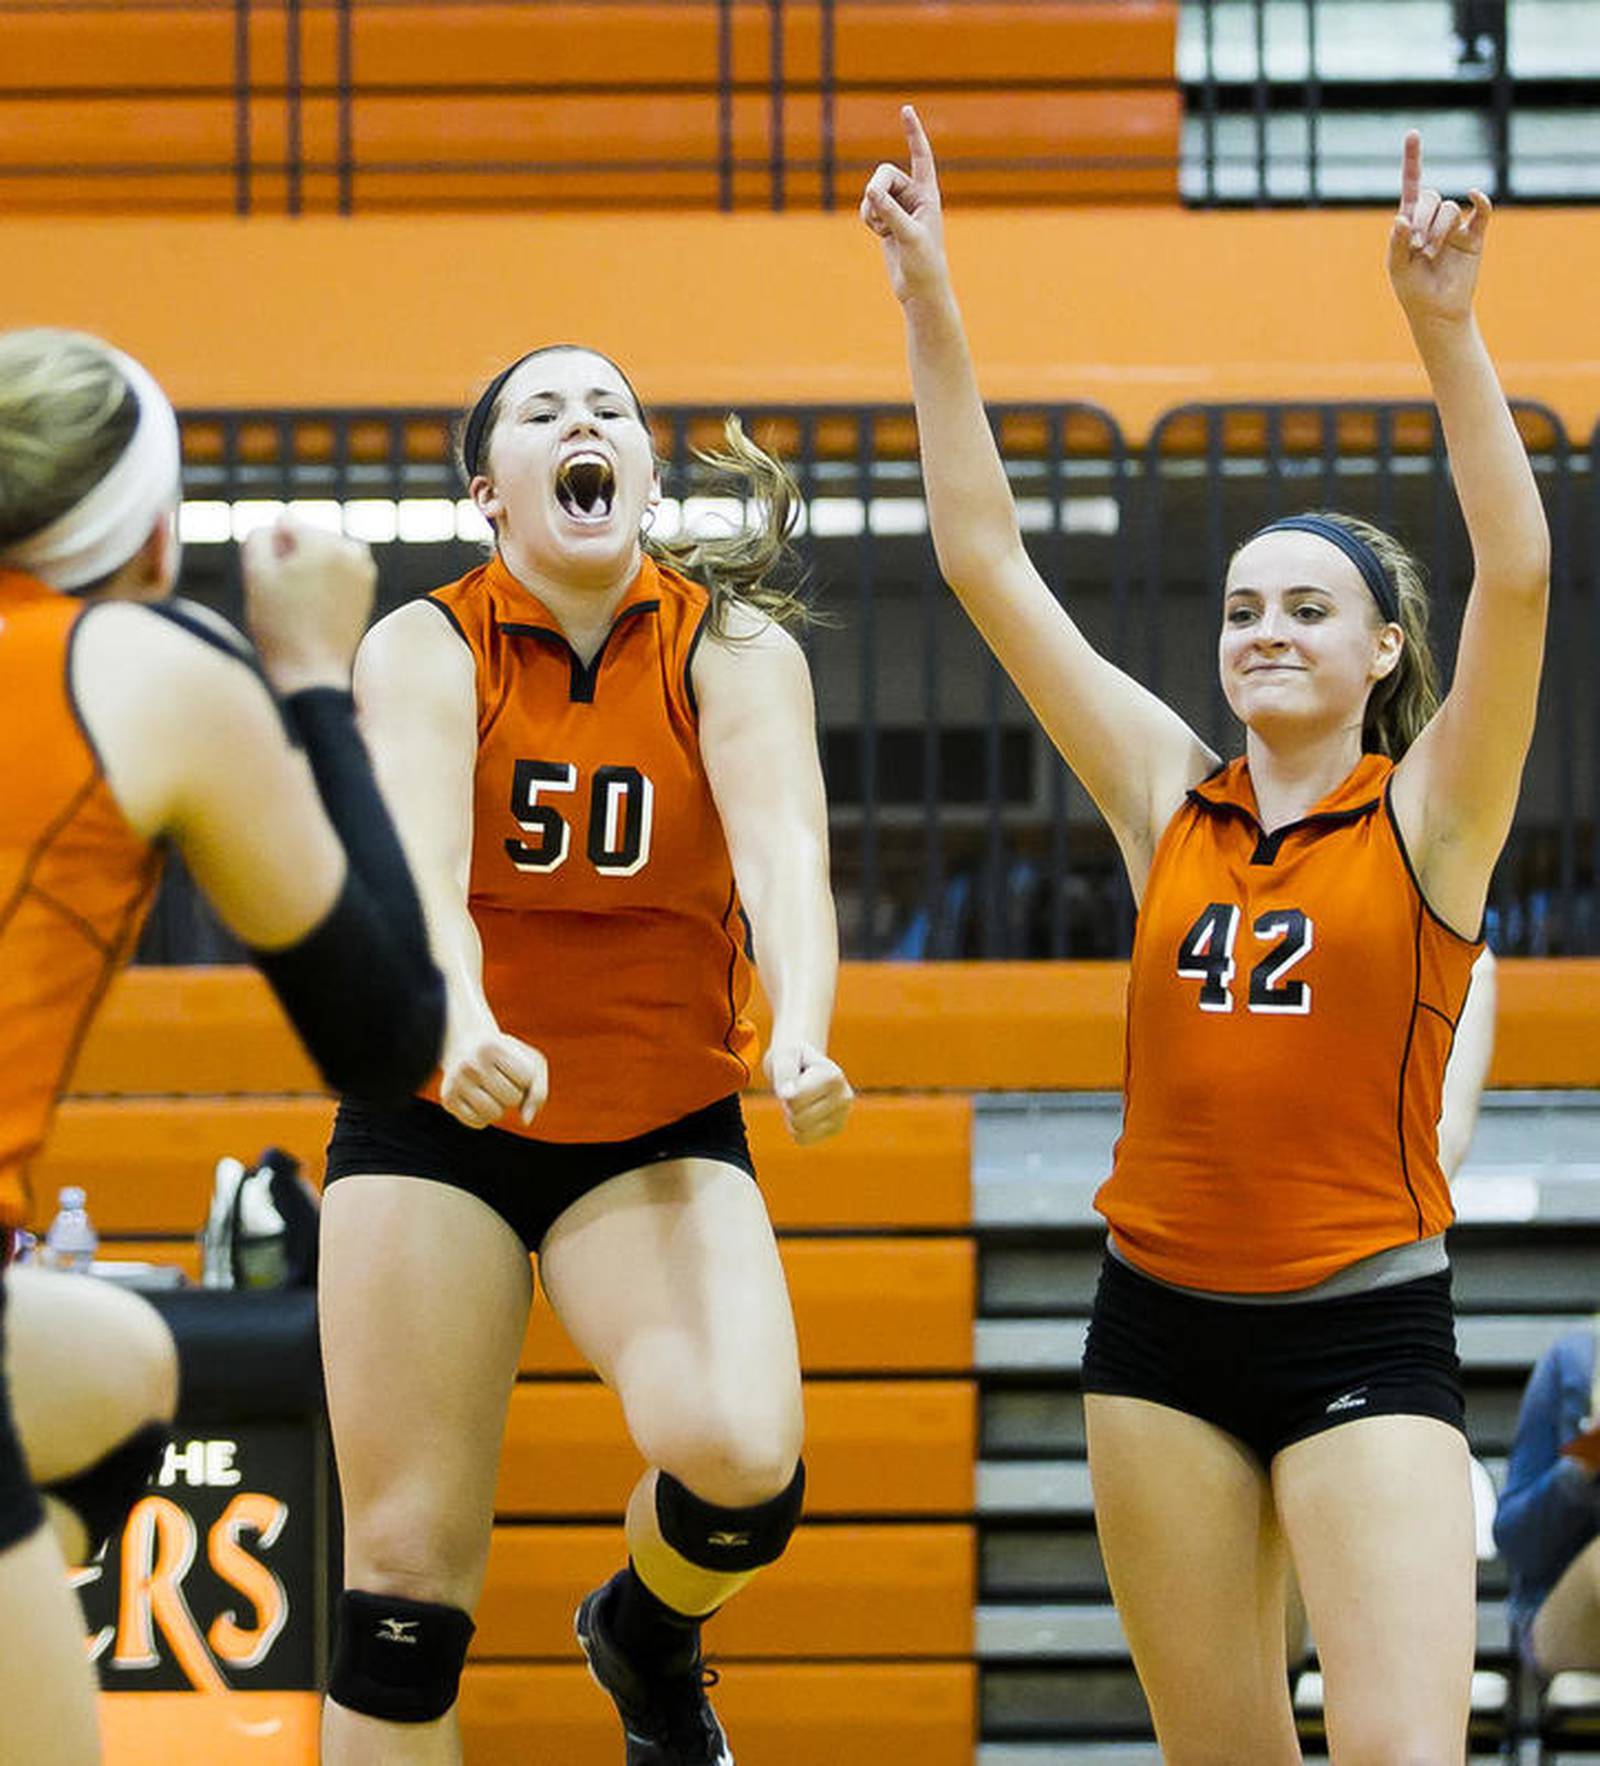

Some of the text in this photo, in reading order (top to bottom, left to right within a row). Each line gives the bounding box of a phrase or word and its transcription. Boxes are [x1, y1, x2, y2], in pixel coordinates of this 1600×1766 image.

[504, 759, 654, 877] 50
[1177, 903, 1313, 1014] 42
[149, 1440, 241, 1486] HE
[64, 1493, 288, 1692] RS
